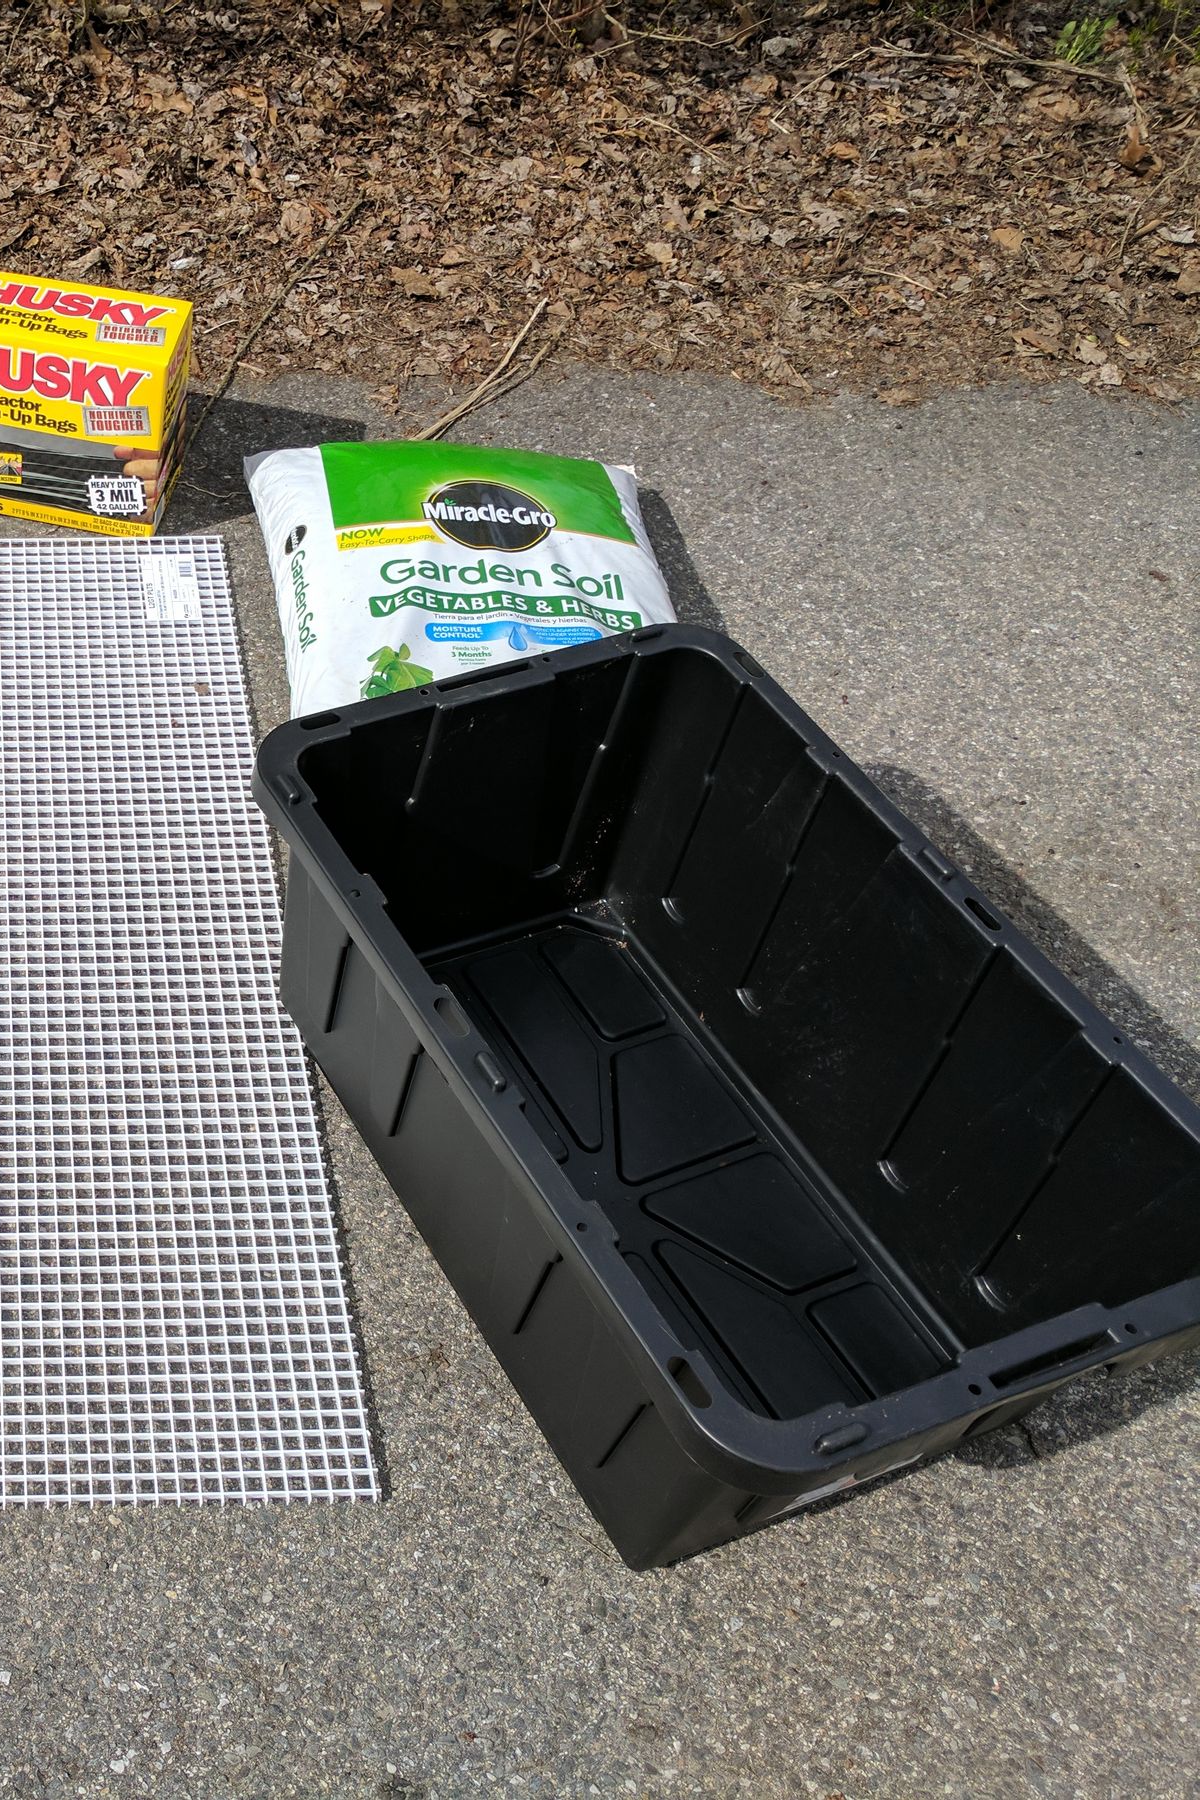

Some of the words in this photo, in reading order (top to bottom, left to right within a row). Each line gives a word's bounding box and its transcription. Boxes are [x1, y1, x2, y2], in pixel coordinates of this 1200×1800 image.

[44, 324, 88, 339] Bags
[104, 325, 159, 335] NOTHING'S
[104, 332, 159, 342] TOUGHER
[89, 410, 142, 420] NOTHING'S
[35, 413, 78, 434] Bags
[90, 420, 144, 431] TOUGHER
[96, 490, 105, 502] 3
[111, 490, 137, 502] MIL
[341, 527, 384, 541] NOW
[339, 536, 405, 549] Easy-To-Carry
[407, 534, 435, 543] Shape
[291, 550, 309, 620] Garden
[380, 558, 542, 587] Garden
[550, 563, 625, 600] Soil
[375, 588, 528, 615] VEGETABLES
[535, 600, 554, 613] &
[561, 599, 635, 630] HERBS
[514, 613, 550, 624] Vegetales
[298, 612, 317, 653] Soil
